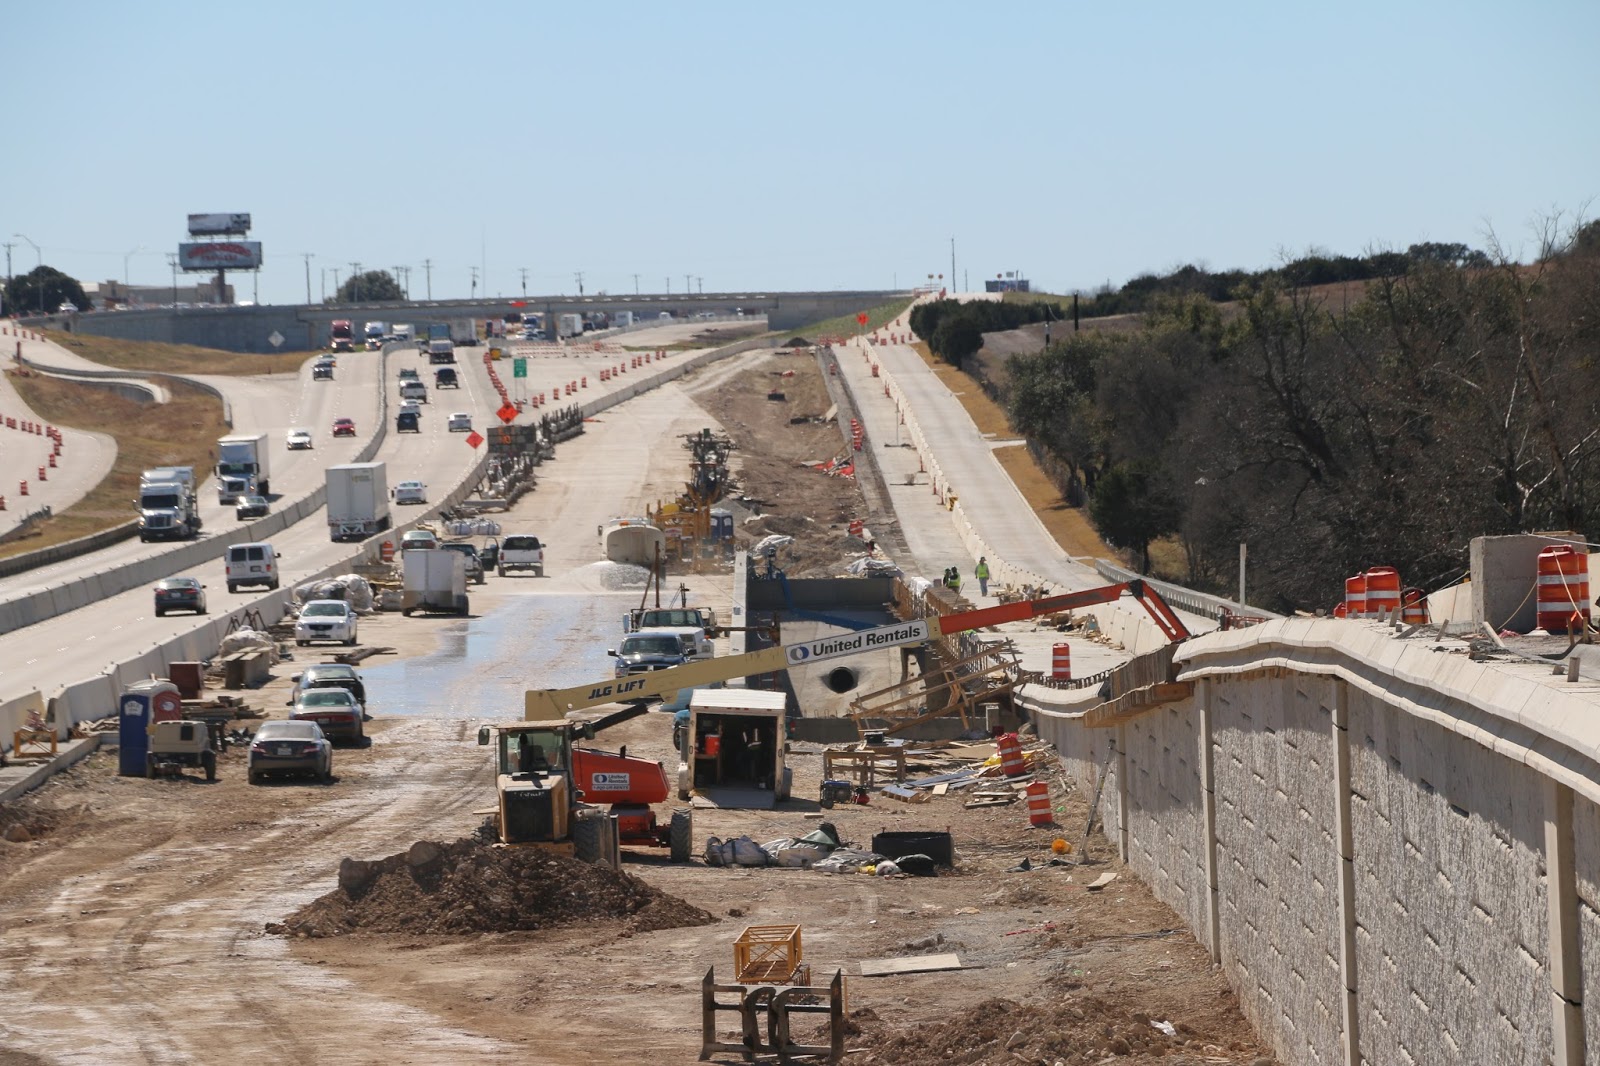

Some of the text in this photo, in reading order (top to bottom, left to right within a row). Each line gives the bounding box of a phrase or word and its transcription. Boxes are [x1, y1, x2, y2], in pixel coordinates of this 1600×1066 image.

[813, 626, 920, 656] United Rentals
[588, 679, 646, 700] JLG LIFT
